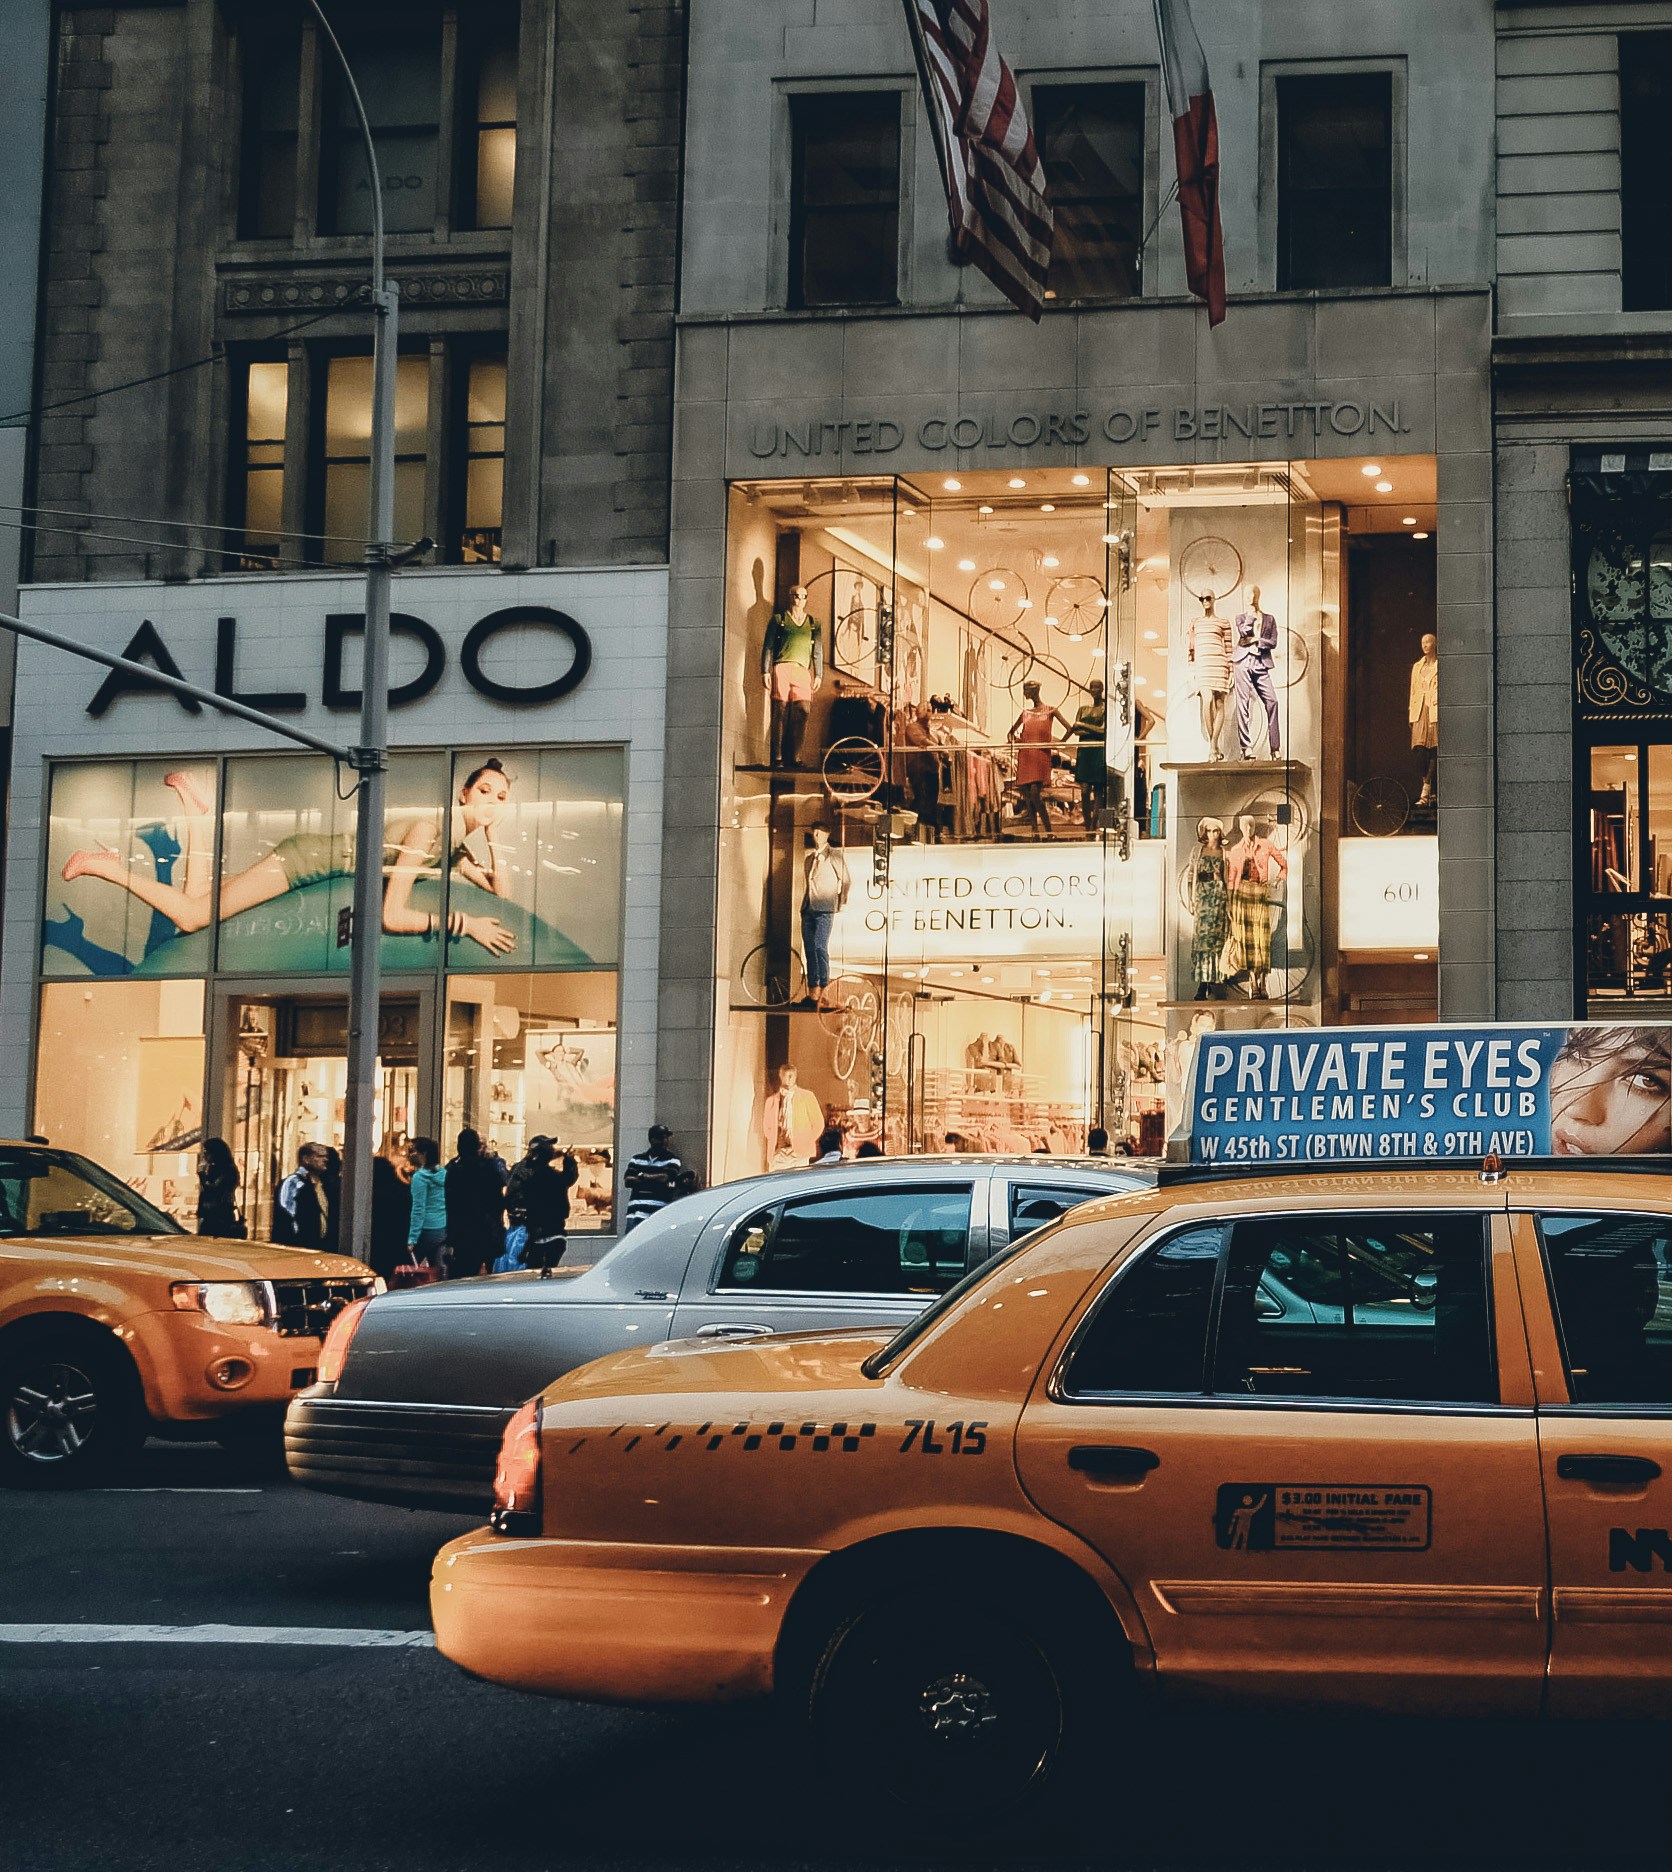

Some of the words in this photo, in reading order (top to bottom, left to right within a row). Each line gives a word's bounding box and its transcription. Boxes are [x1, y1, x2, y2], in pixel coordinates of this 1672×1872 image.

[751, 420, 904, 458] UNITED
[918, 411, 1091, 450] COLORS
[1103, 411, 1162, 442] OF
[1174, 400, 1411, 440] BENETTON.
[86, 605, 592, 716] ALDO
[984, 875, 1098, 897] COLORS
[865, 909, 904, 931] OF
[1204, 1042, 1408, 1093] PRIVATE
[1424, 1039, 1541, 1089] EYES
[1201, 1093, 1435, 1122] GENTLEMEN'S
[1453, 1092, 1536, 1118] CLUB
[1201, 1136, 1219, 1160] W
[1224, 1134, 1271, 1159] 45th
[1276, 1134, 1300, 1158] ST
[1306, 1133, 1373, 1159] (BTWN
[1379, 1132, 1417, 1156] 8TH
[1423, 1131, 1438, 1156] &
[1444, 1132, 1482, 1156] 9TH
[1488, 1130, 1534, 1156] AVE)
[899, 1419, 989, 1455] 7L15
[1326, 1493, 1379, 1506] INITIAL
